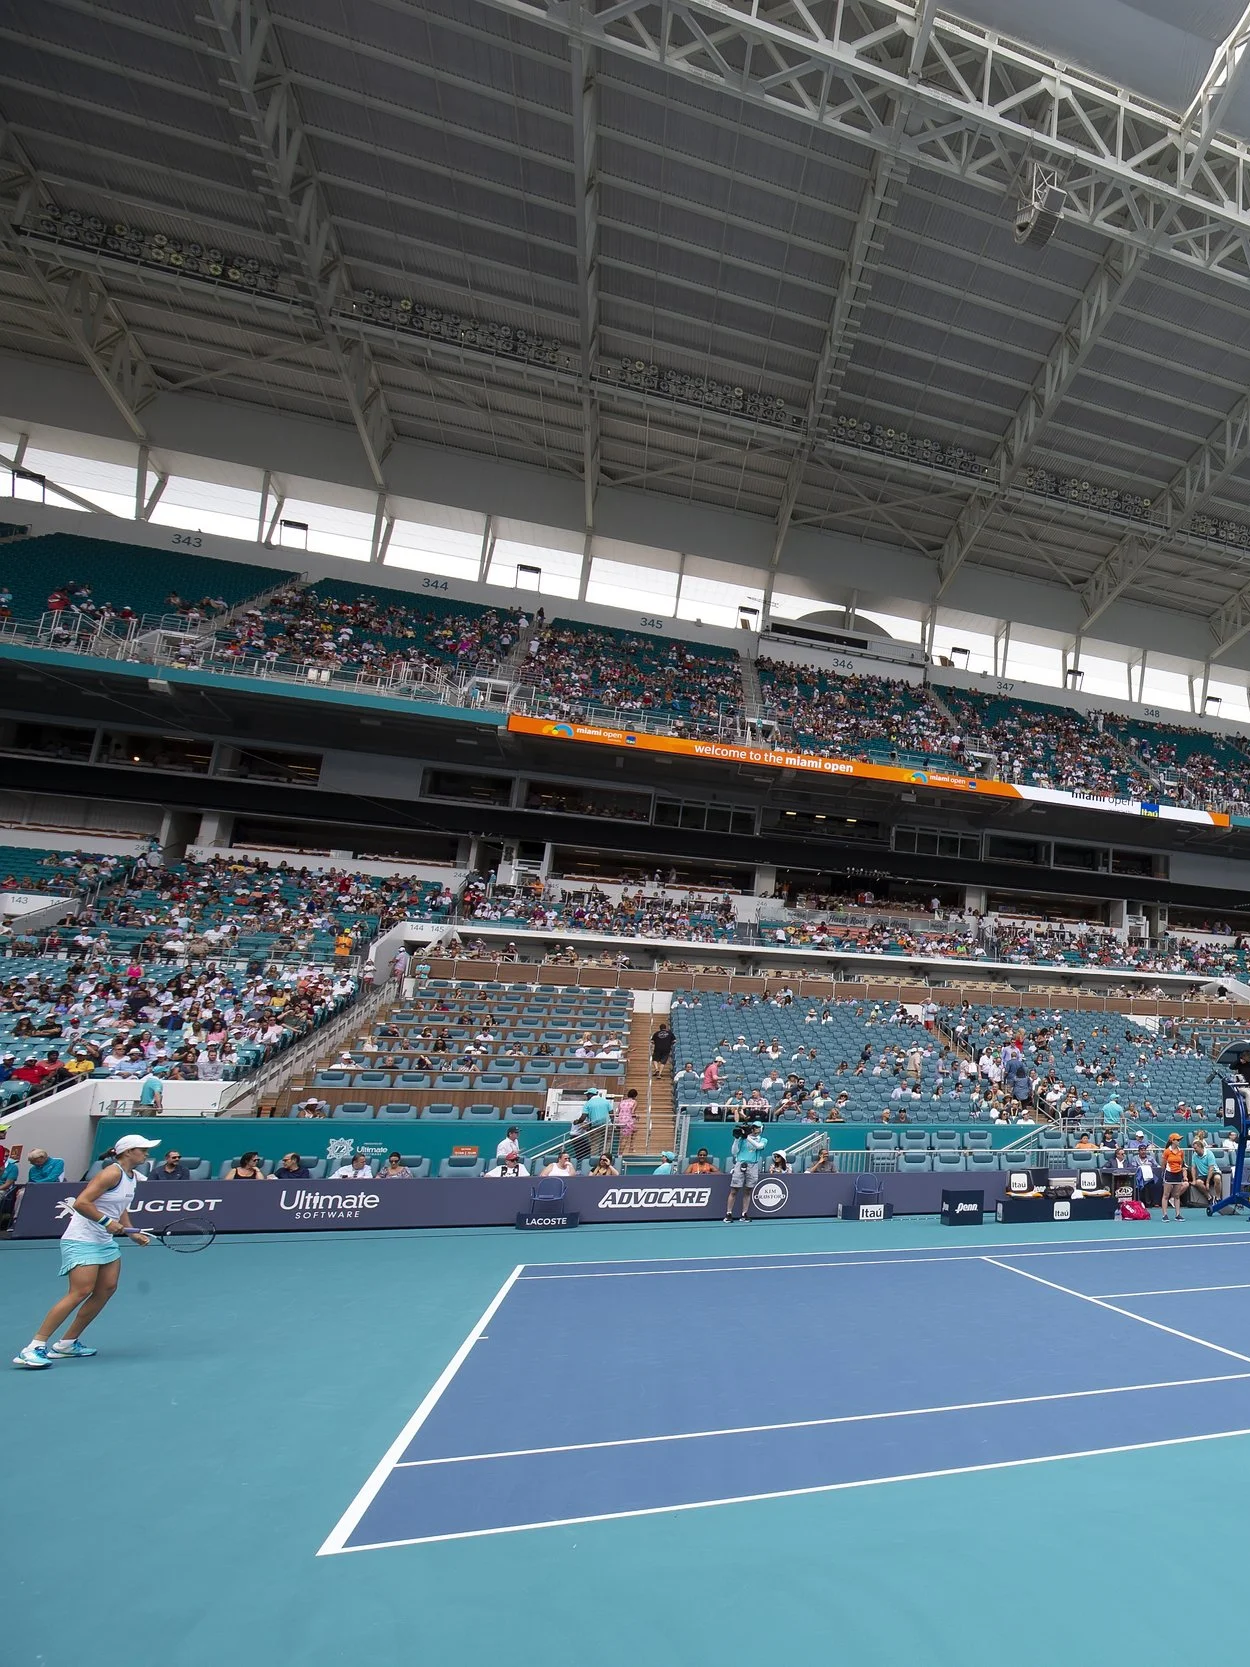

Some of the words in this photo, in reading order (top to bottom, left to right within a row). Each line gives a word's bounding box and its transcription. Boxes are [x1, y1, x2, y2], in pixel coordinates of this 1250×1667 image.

[172, 533, 202, 548] 343
[422, 578, 449, 591] 344
[640, 617, 664, 630] 345
[832, 658, 854, 670] 346
[996, 681, 1015, 693] 347
[1144, 708, 1160, 719] 348
[576, 727, 602, 737] miami
[602, 731, 623, 740] open
[694, 744, 747, 760] welcome
[749, 750, 761, 761] to
[764, 752, 783, 764] the
[785, 755, 822, 769] miami
[824, 761, 853, 773] open
[929, 774, 950, 782] miami
[950, 777, 966, 785] open
[1108, 797, 1134, 807] open
[11, 895, 29, 905] 143
[828, 914, 849, 925] Hard
[410, 923, 424, 932] 144
[356, 1145, 388, 1154] Ultimate
[1081, 1179, 1096, 1187] Itaú
[280, 1190, 380, 1211] Ultimate
[600, 1188, 711, 1208] ADVOCARE
[126, 1199, 223, 1212] UGEOT
[295, 1210, 361, 1220] SOFTWARE
[861, 1206, 882, 1218] Itaú
[1054, 1206, 1069, 1217] Itaú
[525, 1217, 568, 1226] LACOSTE
